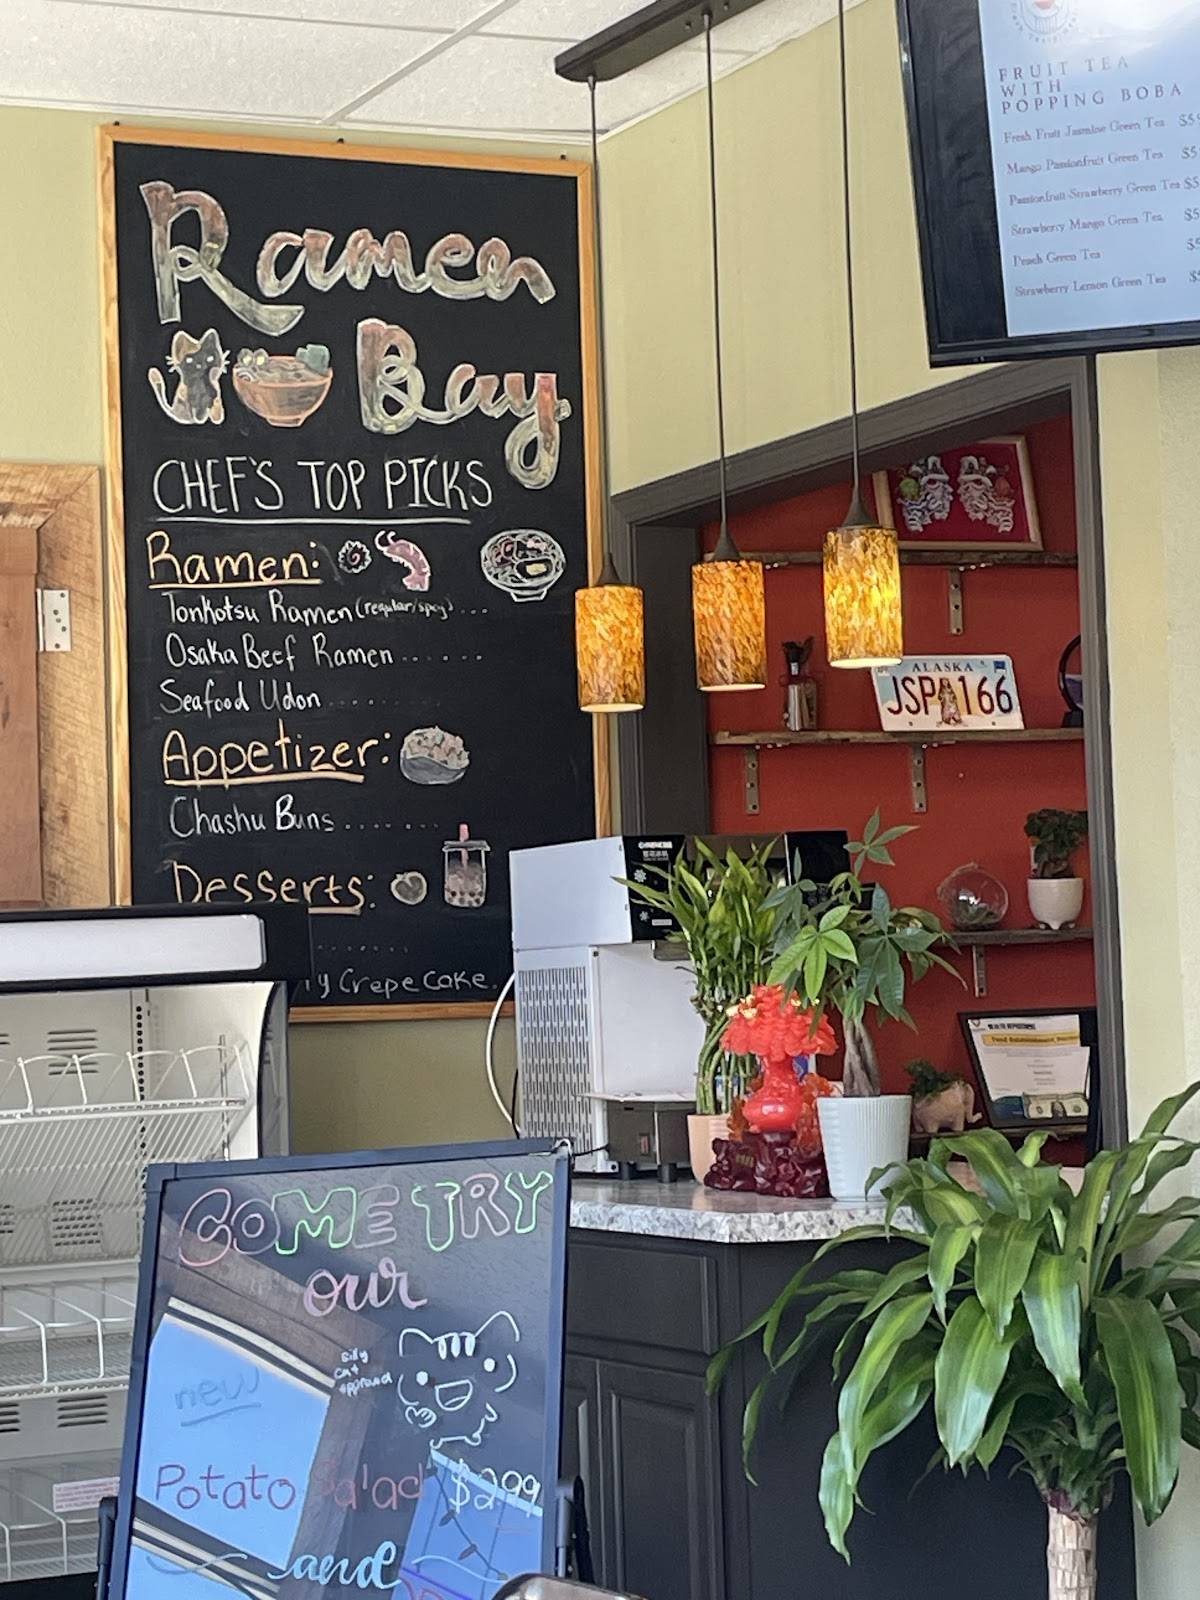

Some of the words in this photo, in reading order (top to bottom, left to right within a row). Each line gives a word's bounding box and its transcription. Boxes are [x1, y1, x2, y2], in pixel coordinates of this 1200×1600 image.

[998, 61, 1069, 82] FRUIT
[1085, 56, 1128, 72] TEA
[1000, 79, 1061, 97] WITH
[1002, 91, 1104, 114] POPPING
[1121, 83, 1182, 101] BOBA
[1004, 131, 1031, 144] Fresh
[1036, 128, 1061, 140] Fruit
[1064, 125, 1106, 137] Jasmine
[1110, 120, 1140, 132] Green
[1144, 117, 1165, 128] Tea
[1007, 162, 1042, 175] Mango
[1046, 155, 1104, 171] Passionfruit
[1108, 152, 1139, 164] Green
[1142, 149, 1163, 160] Tea
[1009, 190, 1066, 206] Passionfruit
[1068, 186, 1122, 201] Strawberry
[1126, 181, 1157, 194] Green
[1160, 179, 1180, 190] Tea
[1011, 222, 1065, 236] Strawberry
[1069, 218, 1105, 231] Mango
[1108, 214, 1139, 226] Green
[1142, 211, 1164, 222] Tea
[139, 180, 556, 336] Ramen
[1013, 253, 1043, 267] Peach
[1046, 251, 1077, 263] Green
[1080, 249, 1100, 260] Tea
[1015, 283, 1069, 297] Strawberry
[1073, 280, 1108, 292] Lemon
[1112, 276, 1142, 288] Green
[1146, 273, 1167, 285] Tea
[357, 318, 571, 488] Bay
[153, 456, 284, 513] CHEF'S
[297, 459, 365, 510] TOP
[384, 457, 492, 510] PICKS
[146, 530, 319, 584] Ramen:
[268, 588, 352, 627] Ramen
[166, 632, 239, 667] Osaka
[242, 632, 296, 671] Beef
[312, 632, 393, 668] Ramen
[912, 661, 974, 672] ALASKA
[160, 678, 250, 719] Seafood
[259, 679, 321, 711] Udon
[888, 676, 935, 715] JSP
[958, 676, 1013, 715] 166
[163, 718, 391, 790] Appetizer:
[170, 796, 266, 838] Chashu
[275, 794, 335, 831] Buns
[172, 860, 376, 909] Desserts:
[339, 968, 419, 999] Crepe
[179, 1186, 400, 1267] COME
[412, 1171, 553, 1251] TRY
[303, 1257, 428, 1317] our
[174, 1366, 261, 1411] new
[156, 1464, 296, 1510] Potato
[321, 1460, 424, 1510] Salad
[267, 1541, 402, 1589] and
